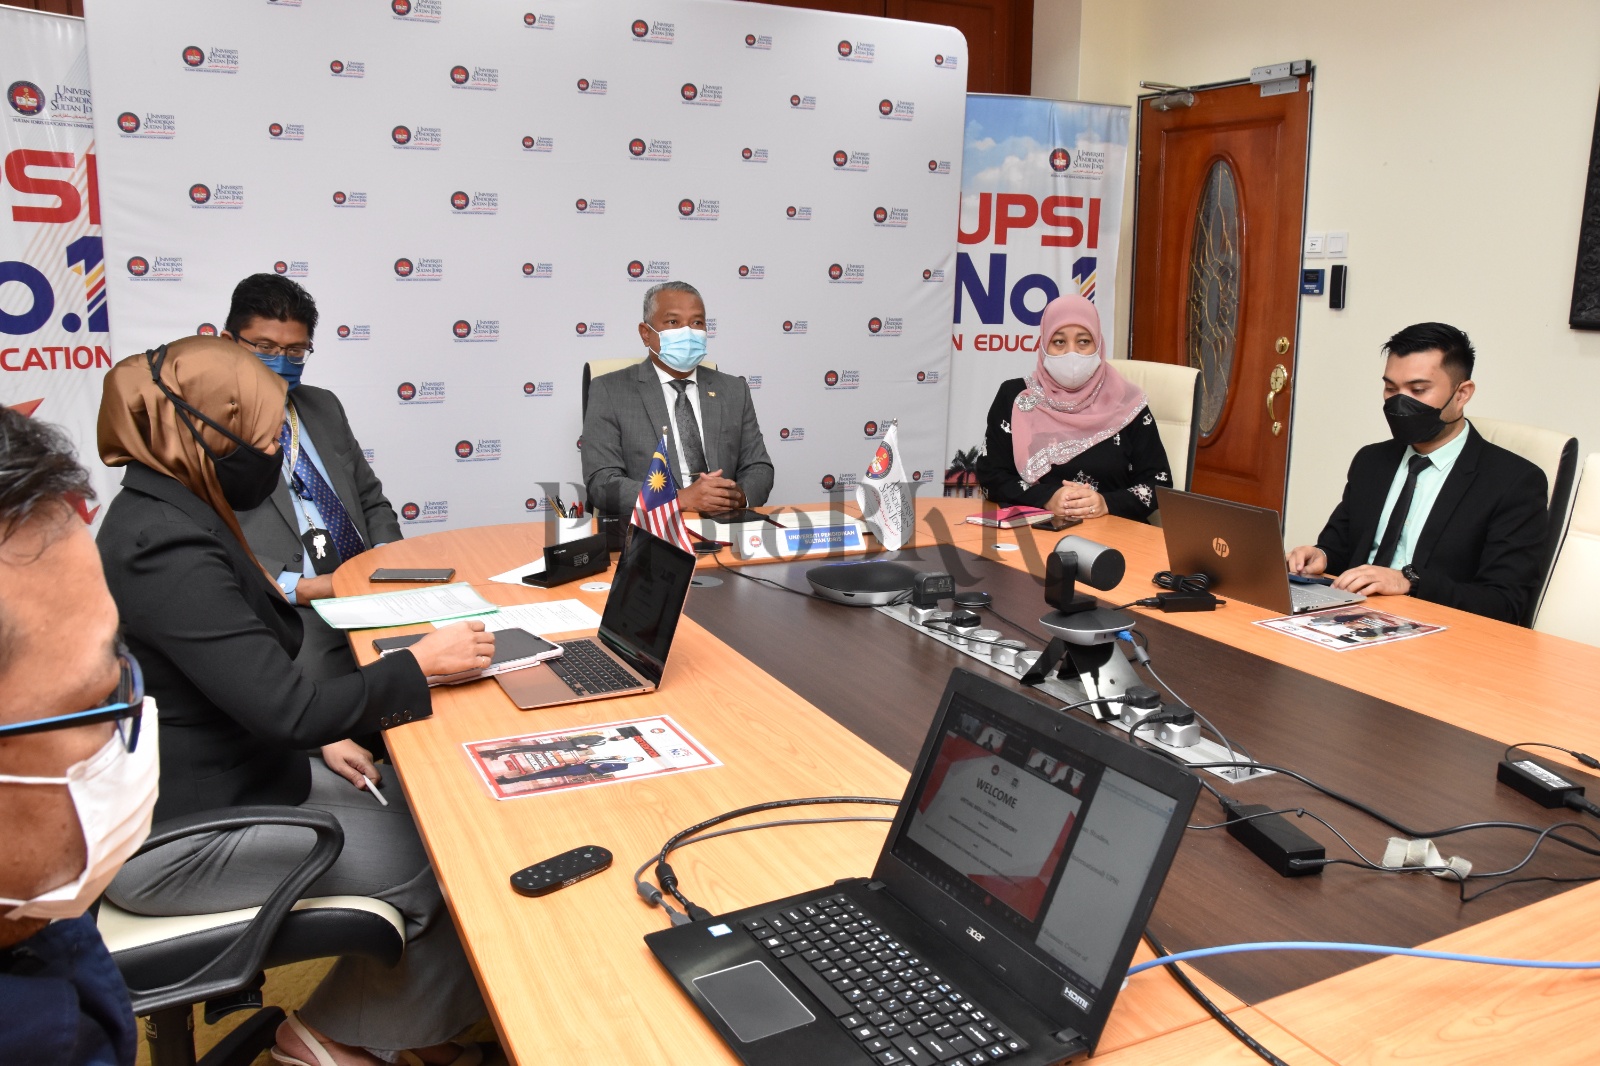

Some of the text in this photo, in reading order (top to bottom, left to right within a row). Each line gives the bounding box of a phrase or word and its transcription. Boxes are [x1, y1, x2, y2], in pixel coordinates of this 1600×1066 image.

[51, 100, 80, 111] SULTAN
[0, 148, 102, 225] SI
[957, 192, 1101, 249] UPSI
[953, 252, 1097, 326] No1
[788, 532, 820, 540] UNIVERSITI
[1215, 537, 1228, 557] hp
[976, 778, 1018, 809] WELCOME
[966, 926, 985, 942] acer
[1064, 986, 1089, 1009] HDMI
